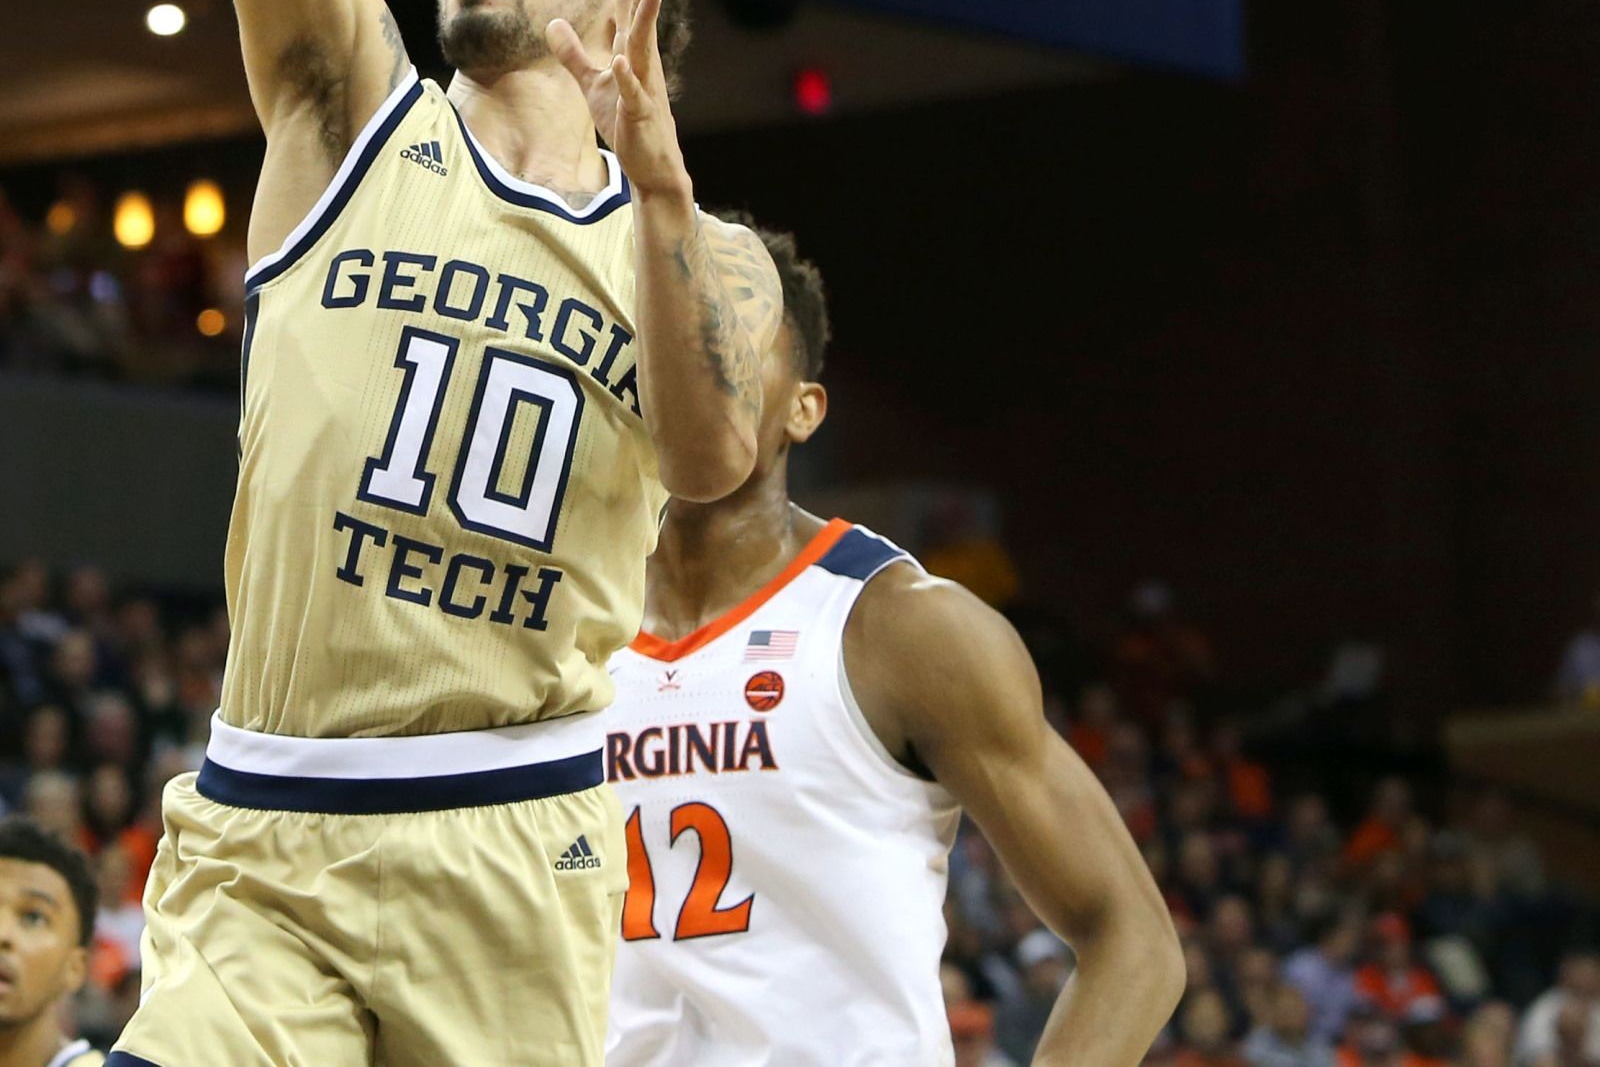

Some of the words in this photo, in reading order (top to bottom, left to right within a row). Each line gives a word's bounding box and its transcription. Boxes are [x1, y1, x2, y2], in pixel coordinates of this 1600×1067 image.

[399, 149, 449, 177] adidas
[356, 325, 584, 553] 10
[334, 511, 562, 631] TECH
[554, 856, 601, 870] adidas
[620, 801, 755, 942] 12
